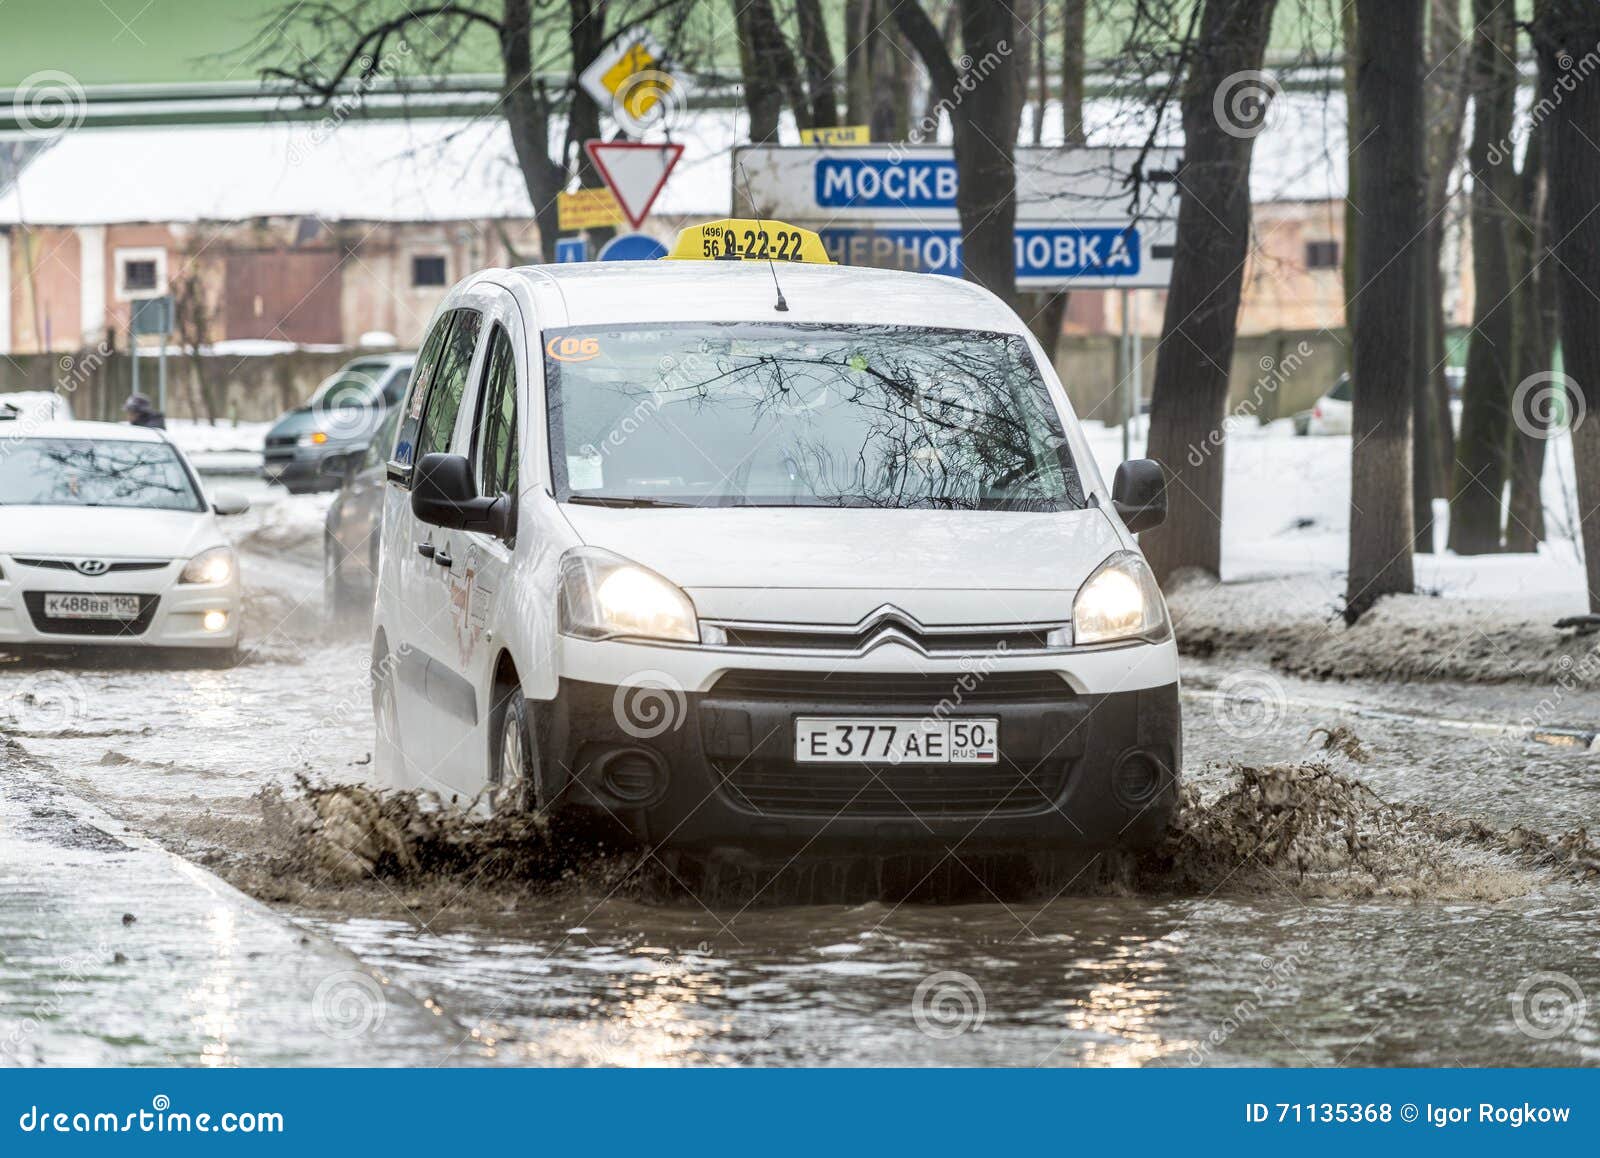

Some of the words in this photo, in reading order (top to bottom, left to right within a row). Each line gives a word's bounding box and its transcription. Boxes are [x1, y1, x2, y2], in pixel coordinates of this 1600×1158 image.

[823, 165, 959, 200] МОСКВ
[702, 225, 724, 239] (496)
[703, 239, 720, 258] 56
[954, 725, 985, 748] 50
[952, 750, 976, 758] RUS
